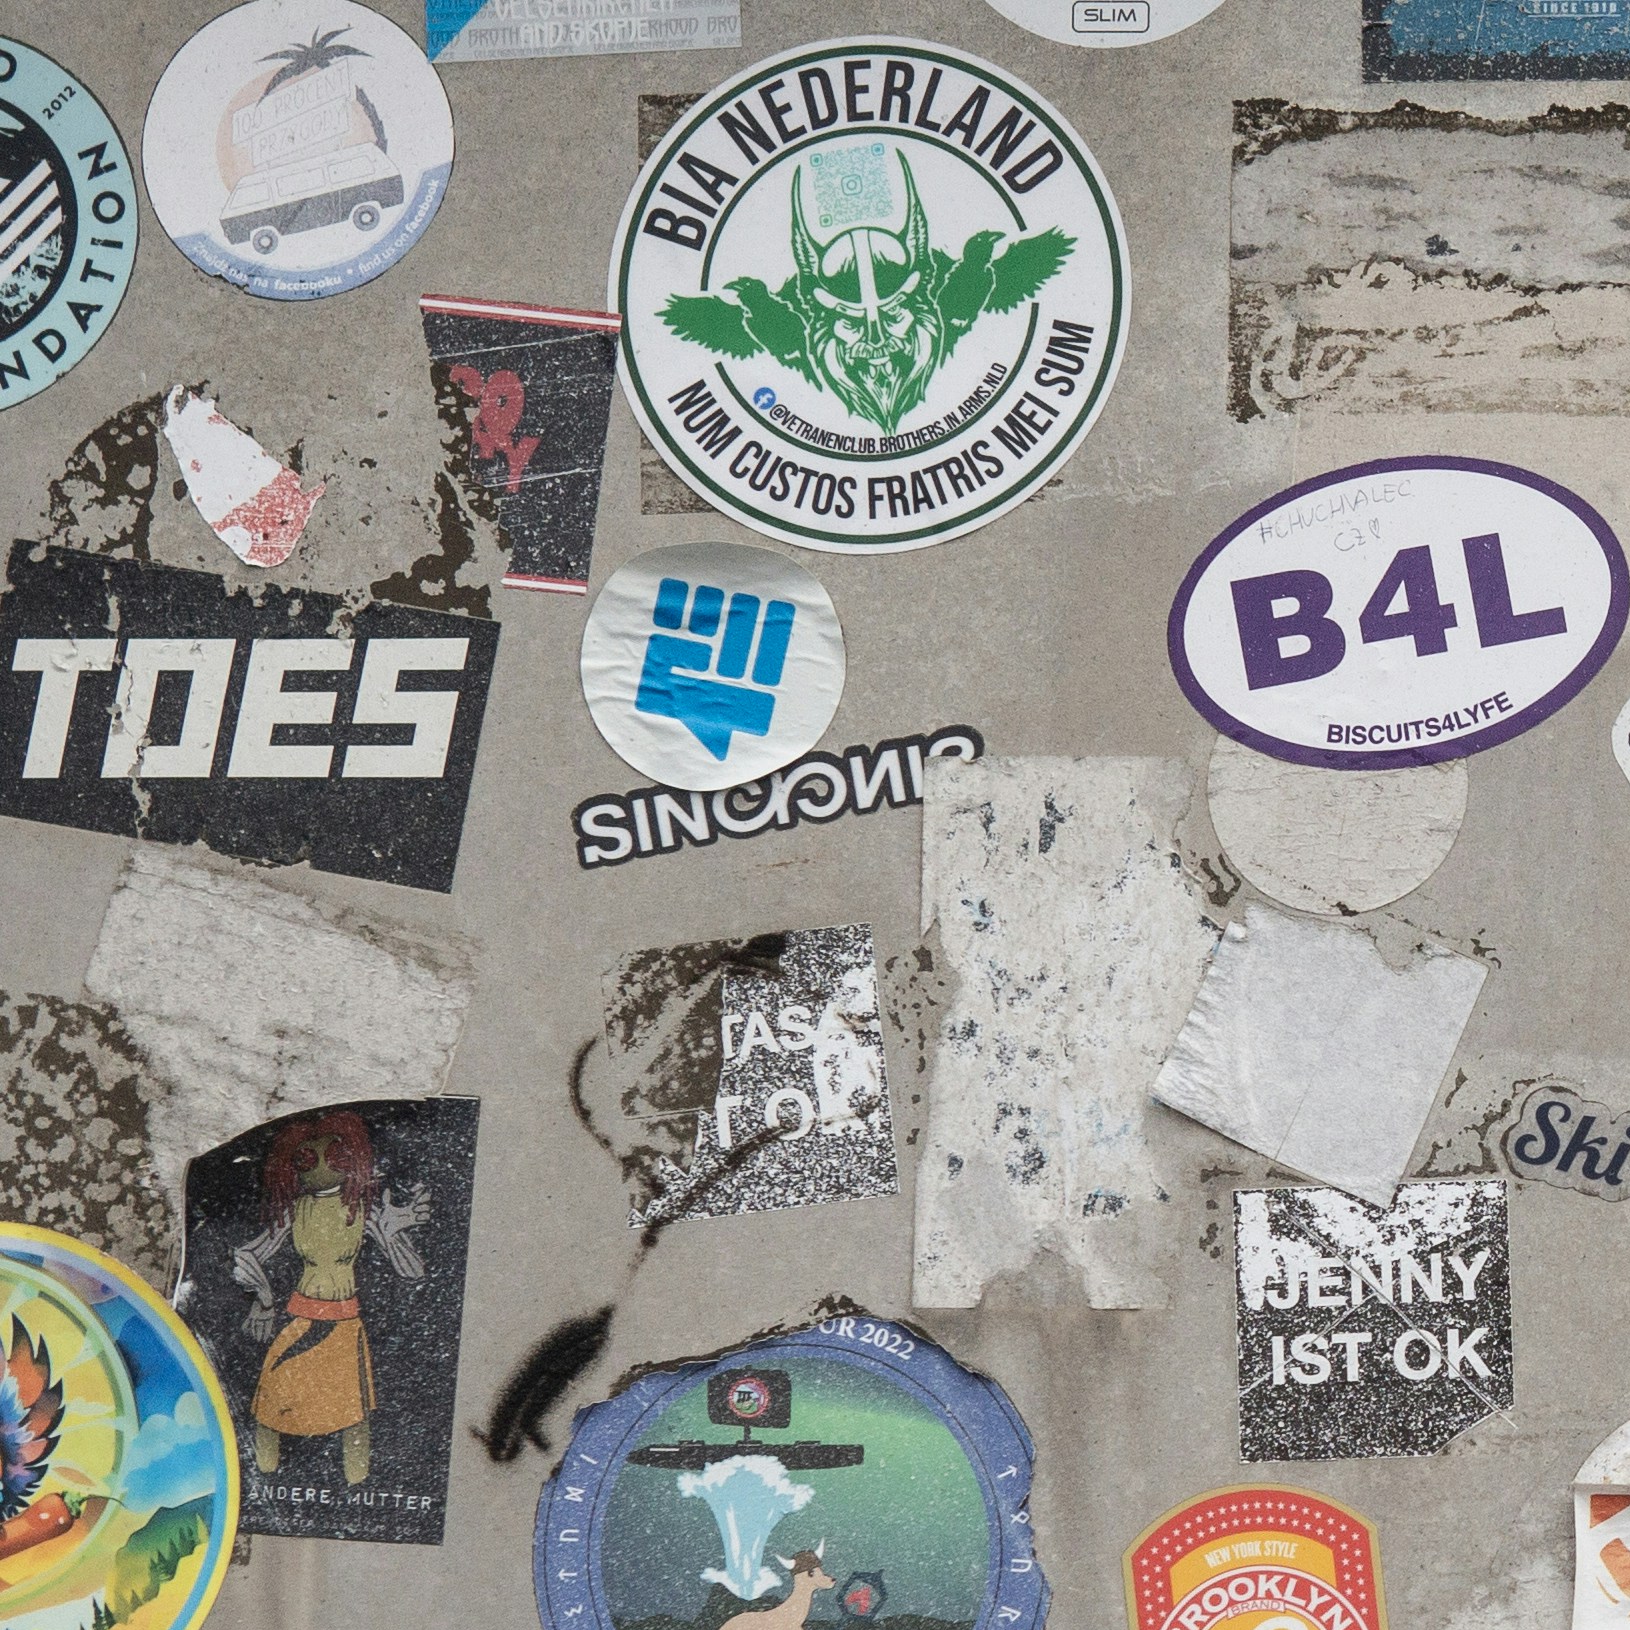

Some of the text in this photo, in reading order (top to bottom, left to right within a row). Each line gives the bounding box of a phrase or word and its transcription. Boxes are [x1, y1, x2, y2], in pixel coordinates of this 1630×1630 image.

[1084, 7, 1138, 23] SLIM
[42, 86, 78, 121] 2012
[642, 59, 1064, 252] BIA NEDERLAND
[358, 254, 382, 276] find
[379, 244, 397, 262] us
[405, 178, 441, 234] facebook
[254, 277, 268, 289] na
[666, 320, 1094, 520] NUM CUSTOS FRATRIS MEI SUM
[1230, 533, 1568, 691] B4L
[1327, 691, 1514, 746] BISCUITS4LYFE
[1271, 1251, 1488, 1309] JENNY
[860, 1320, 916, 1360] 2022
[1271, 1327, 1492, 1387] IST OK
[248, 1486, 432, 1511] ANDERE MUTTER
[1205, 1540, 1299, 1569] NEW YORK STYLE
[1231, 1600, 1282, 1615] BRAND
